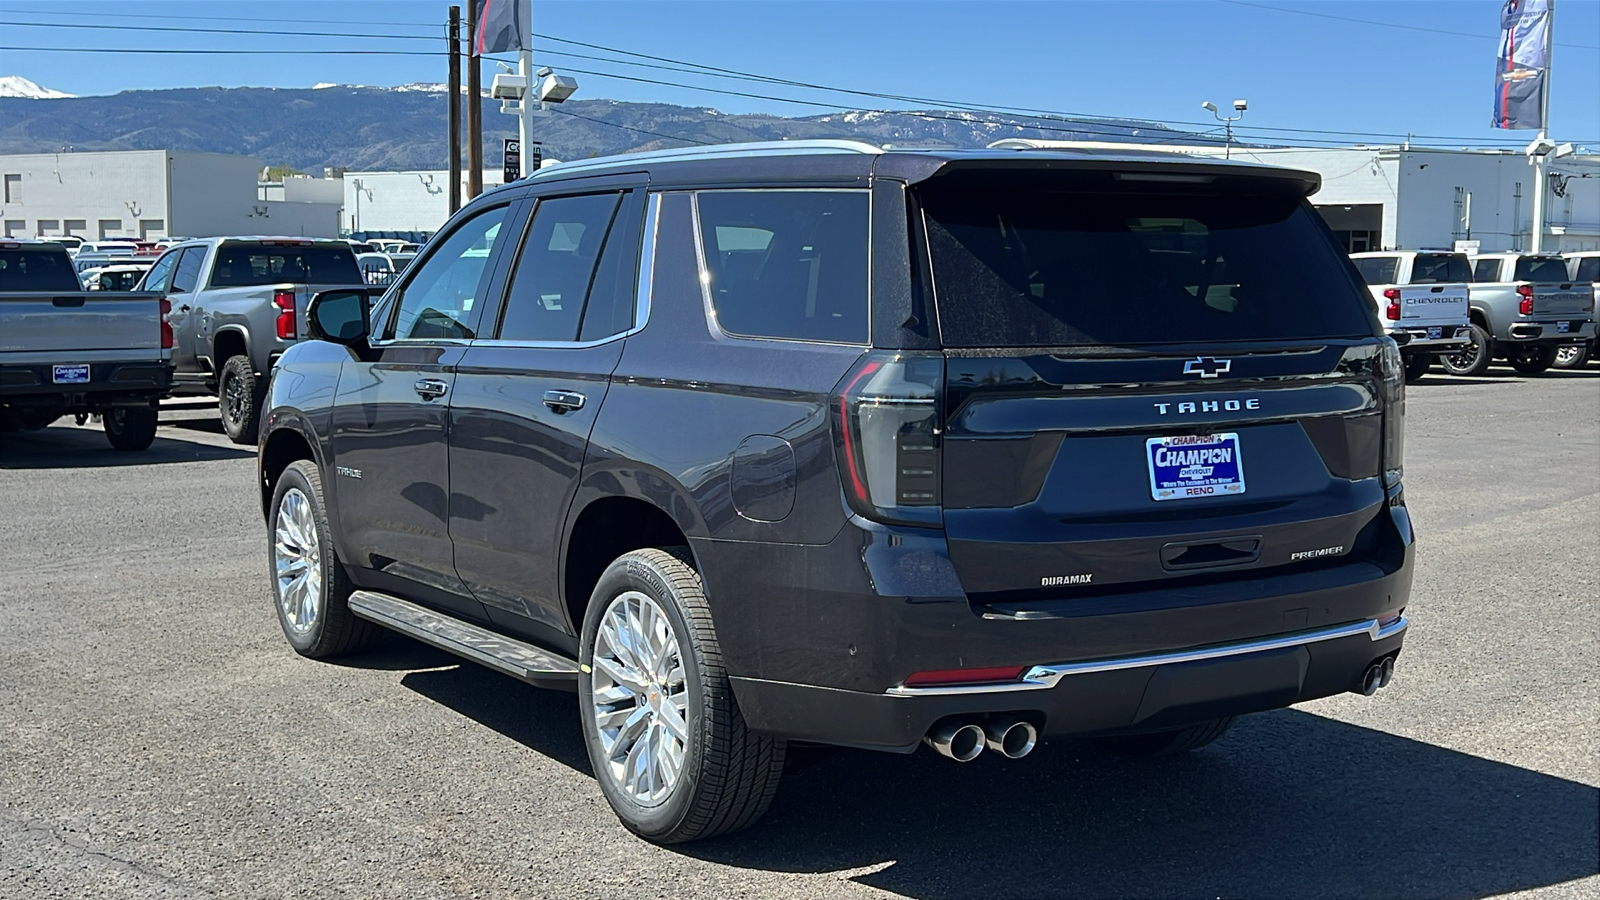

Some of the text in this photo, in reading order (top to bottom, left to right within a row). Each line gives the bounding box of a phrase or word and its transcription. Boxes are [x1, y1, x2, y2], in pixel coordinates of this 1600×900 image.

[1153, 398, 1260, 415] TAHOE
[1173, 436, 1214, 445] CHAMPION
[1155, 447, 1232, 468] CHAMPION
[336, 466, 362, 479] TAHOE
[1181, 468, 1211, 476] CHEVROLET
[1186, 487, 1214, 495] RENO
[1290, 545, 1343, 561] PREMIER
[1041, 573, 1092, 586] DURAMAX
